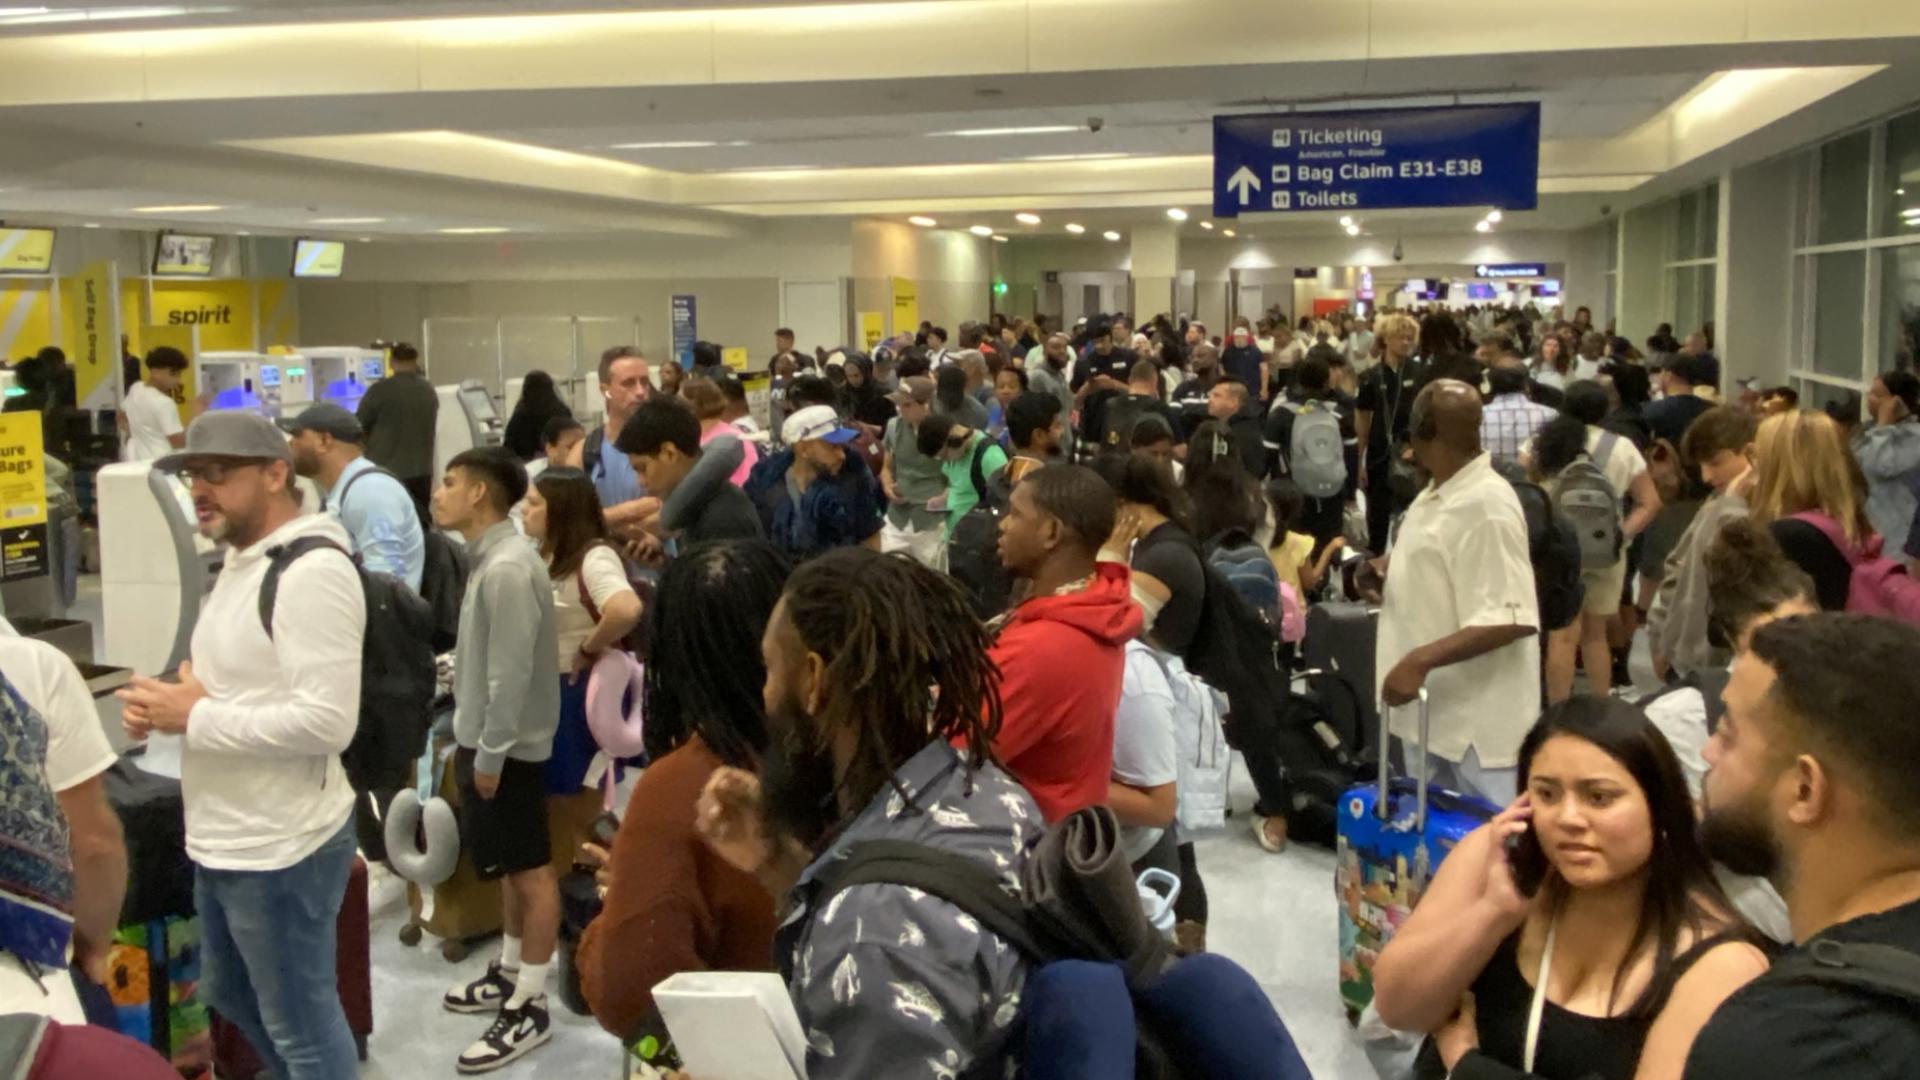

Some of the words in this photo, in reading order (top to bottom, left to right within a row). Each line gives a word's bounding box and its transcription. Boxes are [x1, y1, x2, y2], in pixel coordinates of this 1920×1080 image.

[1298, 127, 1382, 146] Ticketing
[1297, 165, 1333, 185] Bag
[1339, 162, 1393, 180] Claim
[1399, 159, 1482, 178] E31-E38
[1296, 190, 1358, 207] Toilets
[168, 304, 231, 325] spirit
